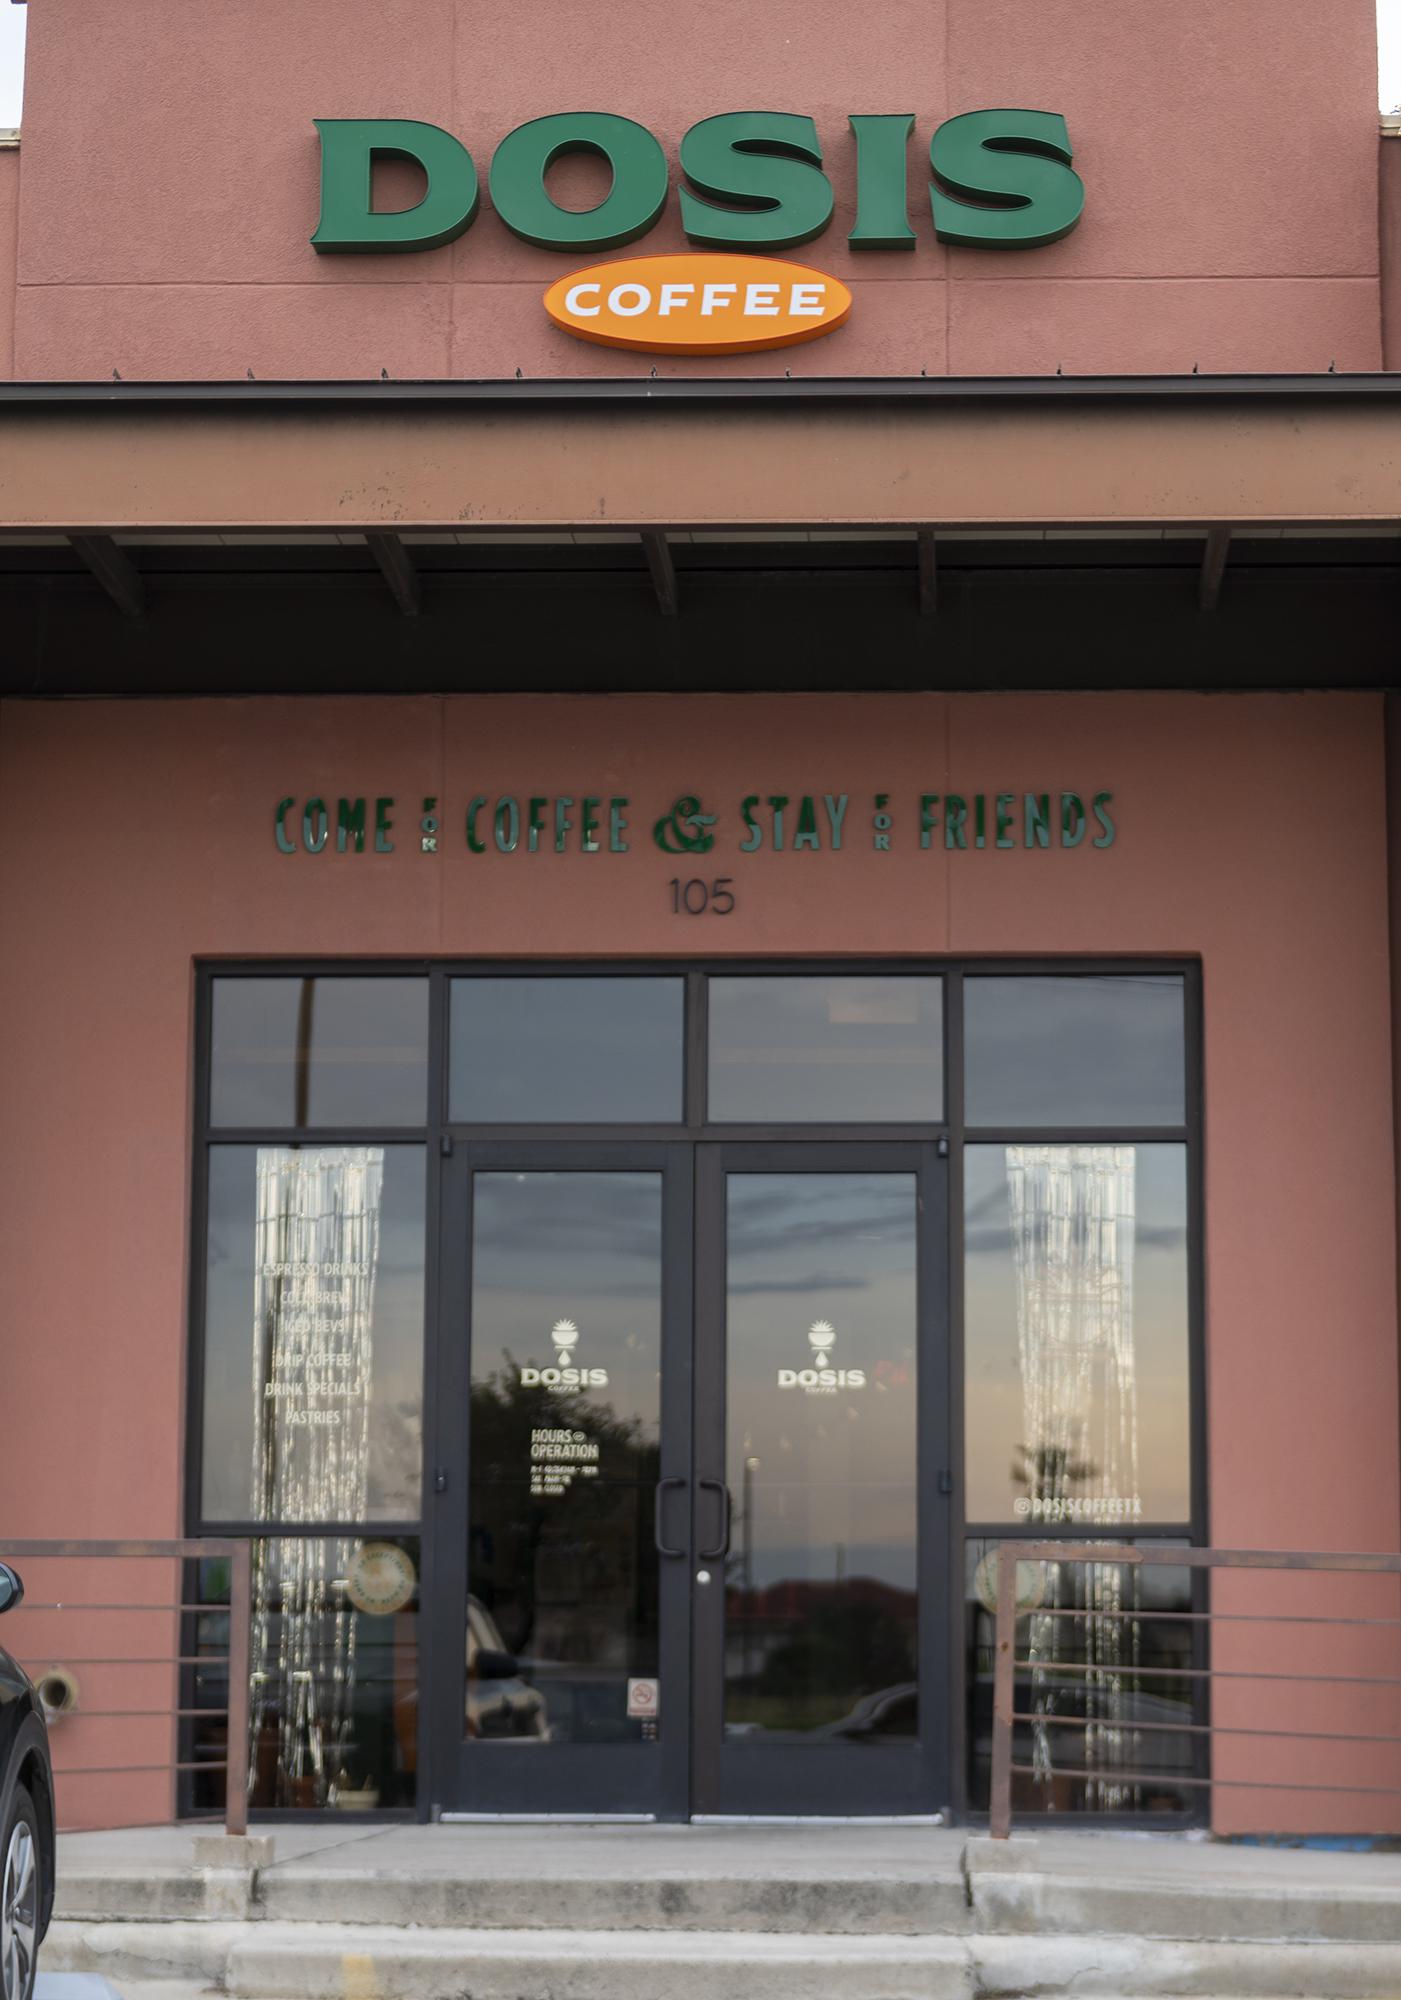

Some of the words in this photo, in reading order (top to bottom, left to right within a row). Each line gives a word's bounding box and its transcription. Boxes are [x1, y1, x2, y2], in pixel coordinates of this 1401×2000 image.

[311, 108, 1086, 254] DOSIS
[564, 283, 826, 317] COFFEE
[276, 796, 393, 853] COME
[467, 796, 629, 853] COFFEE
[653, 795, 718, 854] &
[740, 794, 848, 852] STAY
[920, 792, 1117, 850] FRIENDS
[670, 878, 736, 915] 105
[263, 1262, 319, 1275] ESPRESSO
[324, 1262, 369, 1275] DRINKS
[306, 1354, 352, 1367] COFFEE
[520, 1367, 608, 1385] DOSIS
[777, 1369, 866, 1386] DOSIS
[265, 1383, 303, 1395] DRINK
[306, 1382, 361, 1395] SPECIALS
[285, 1410, 341, 1424] PASTRIES
[531, 1429, 572, 1443] HOURS
[530, 1443, 599, 1458] OPERATION
